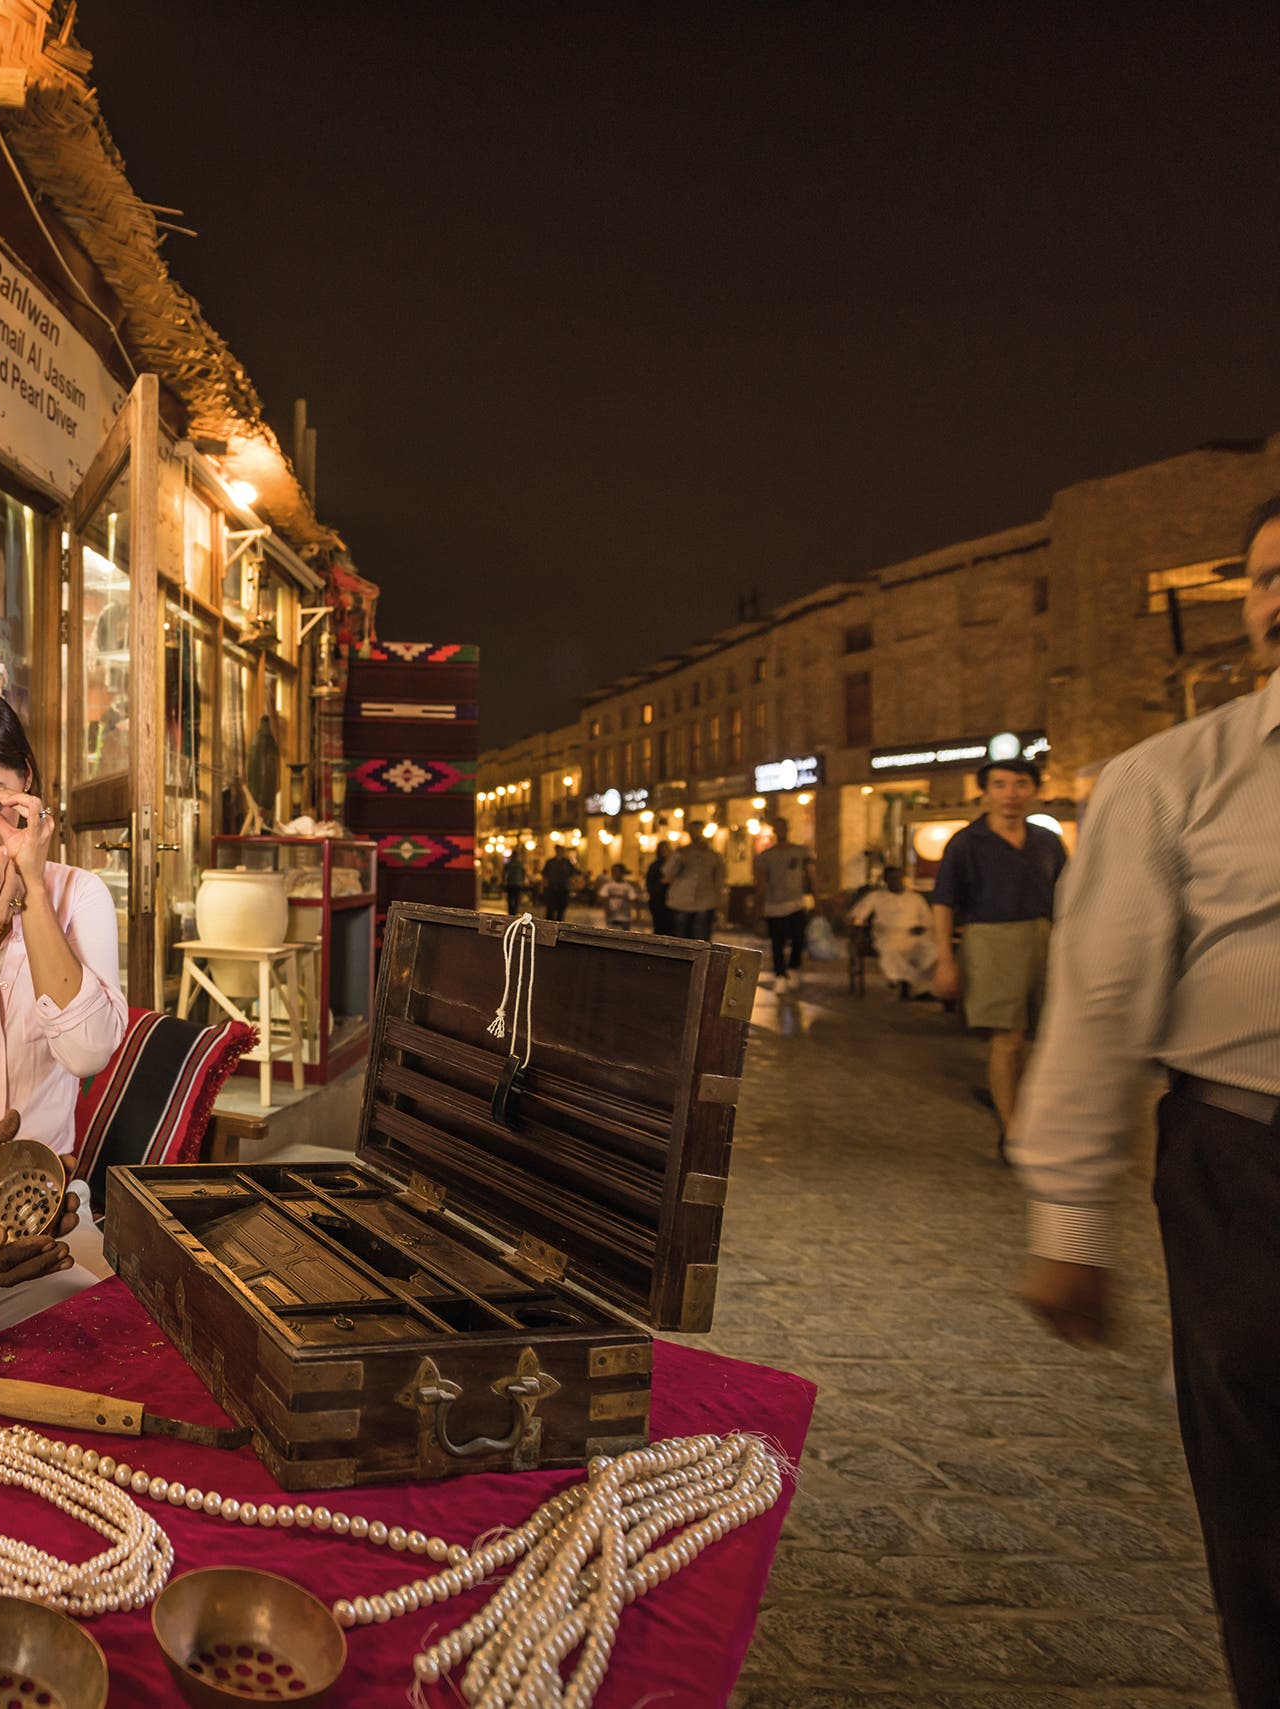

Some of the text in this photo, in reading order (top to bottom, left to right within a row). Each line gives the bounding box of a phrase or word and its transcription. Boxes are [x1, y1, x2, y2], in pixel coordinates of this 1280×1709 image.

[11, 362, 44, 413] Pearl
[47, 393, 78, 439] Diver
[27, 341, 42, 374] Al
[44, 357, 86, 412] Jassim
